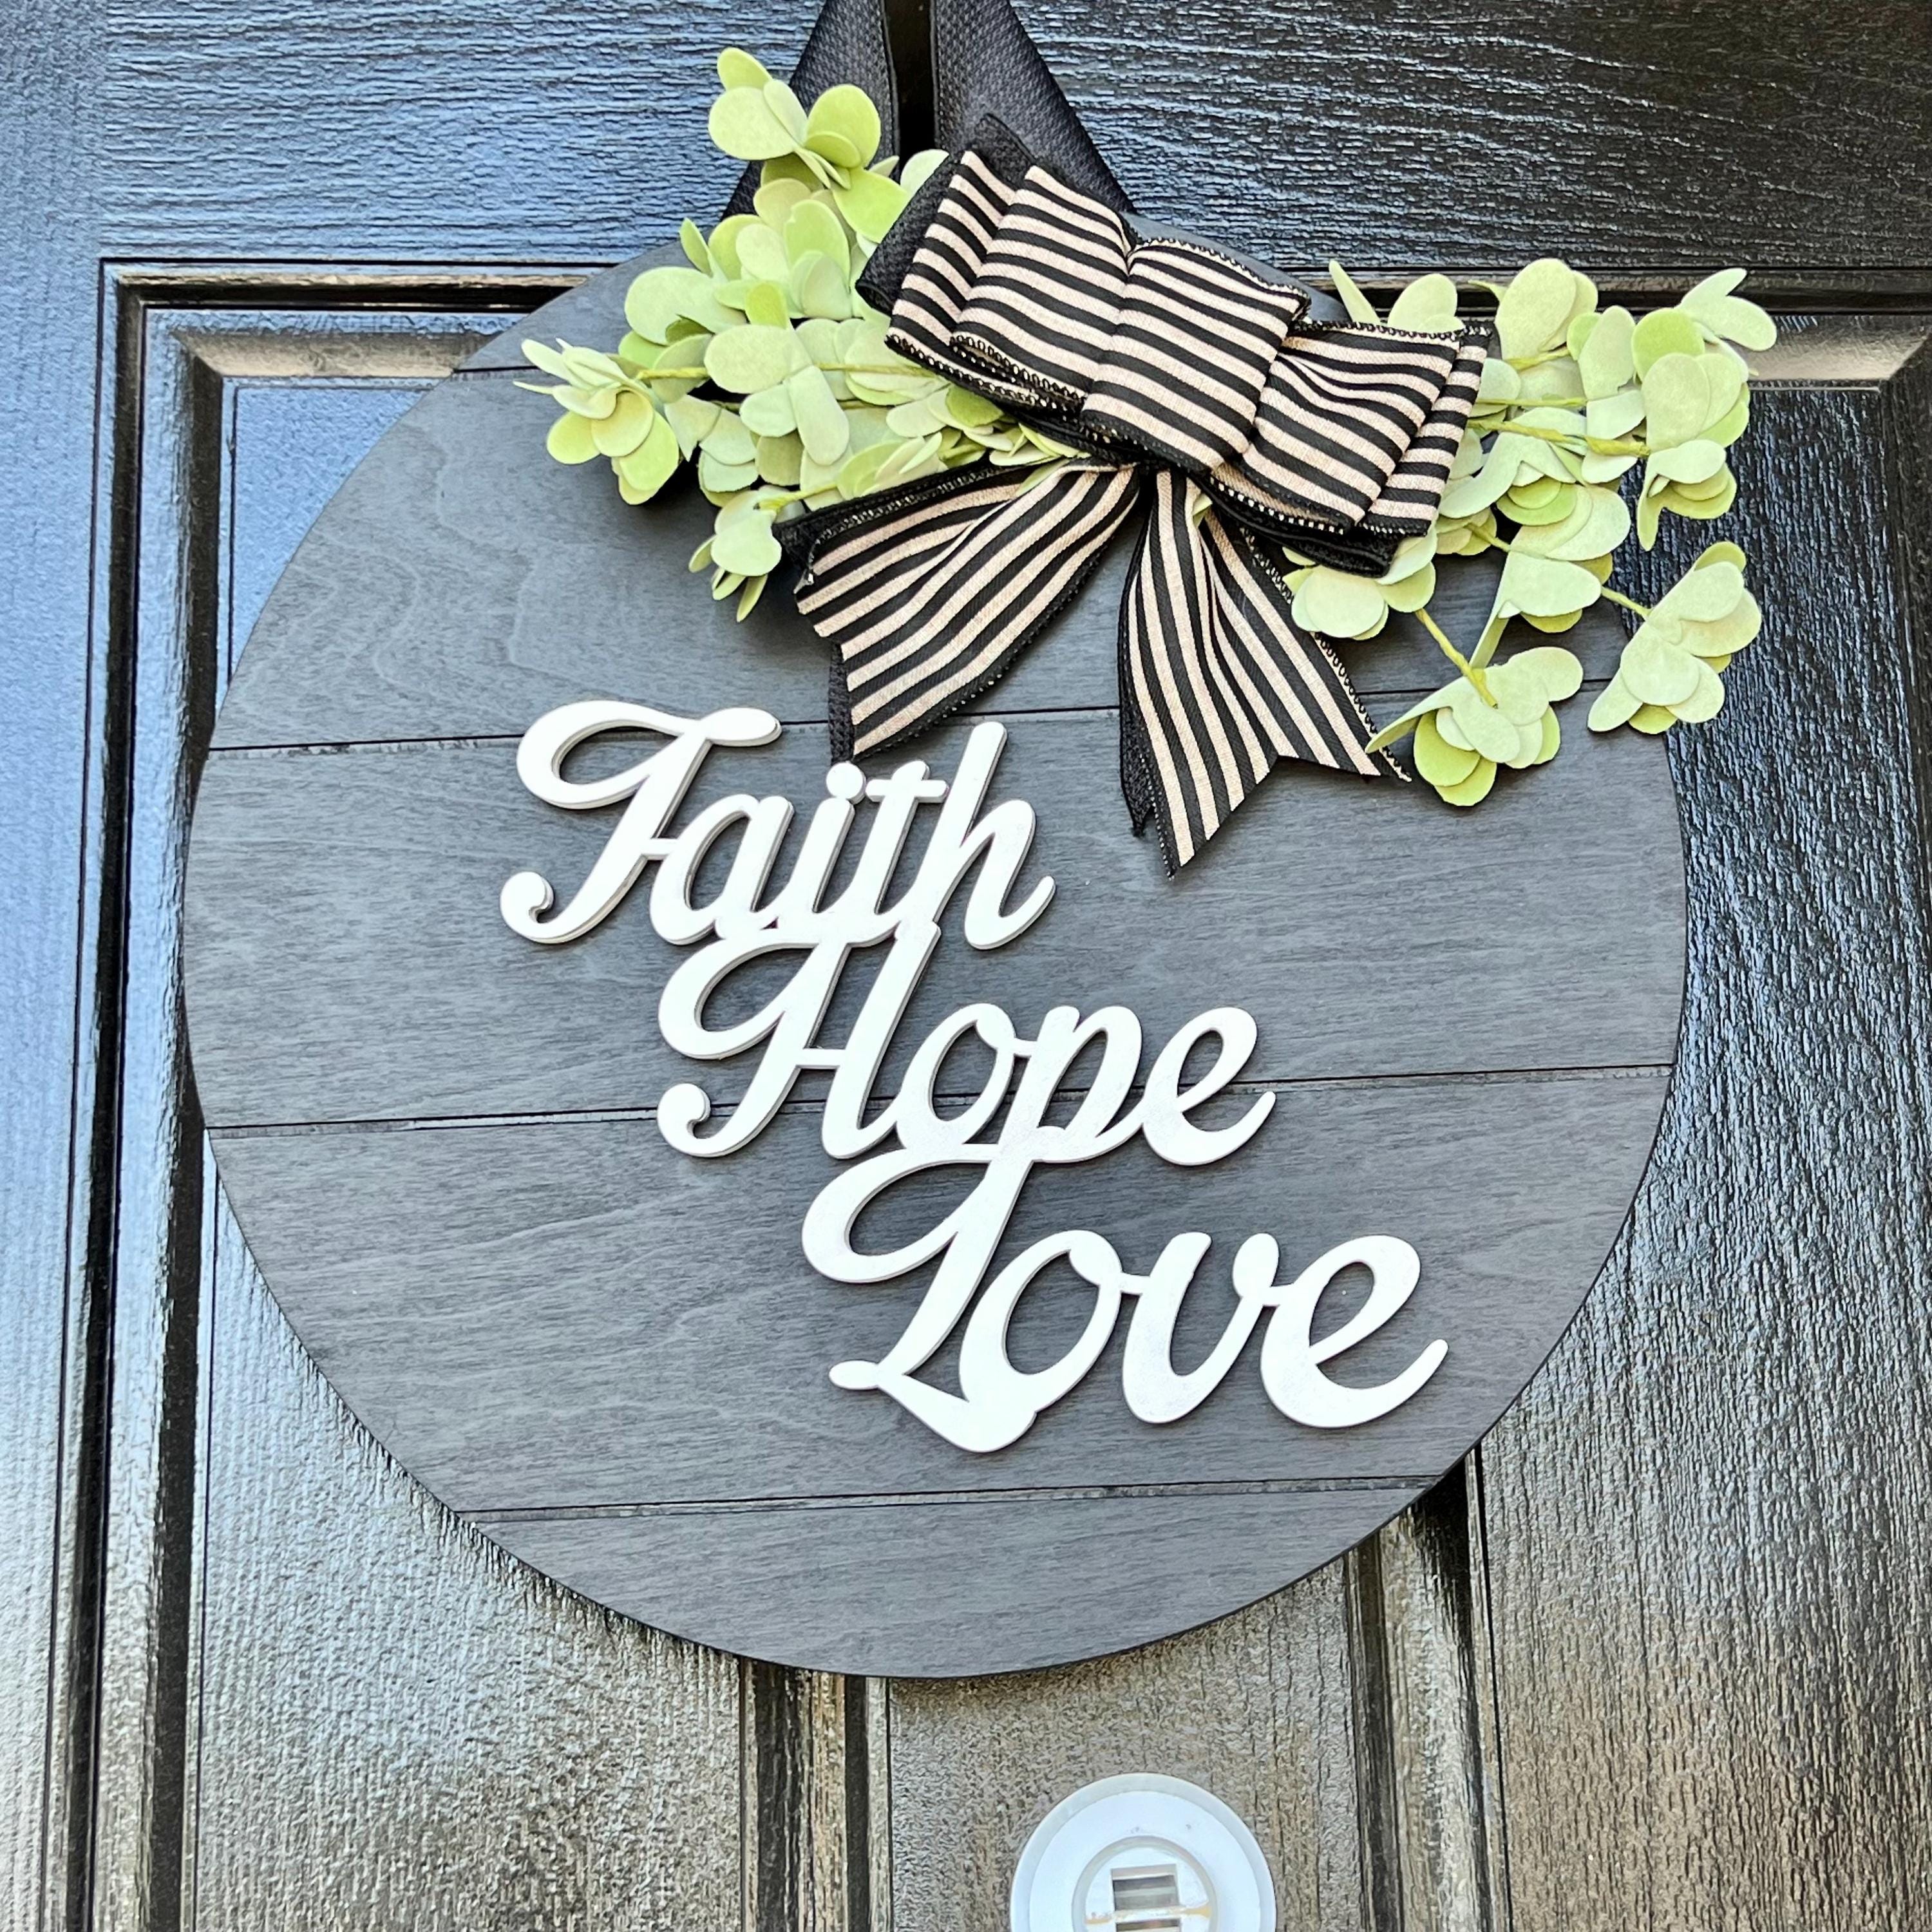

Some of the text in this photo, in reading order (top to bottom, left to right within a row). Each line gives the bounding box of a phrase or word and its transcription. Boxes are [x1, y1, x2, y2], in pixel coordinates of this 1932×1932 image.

[500, 700, 1056, 950] Faith
[657, 921, 1276, 1166] Hope
[801, 1144, 1448, 1452] Love
